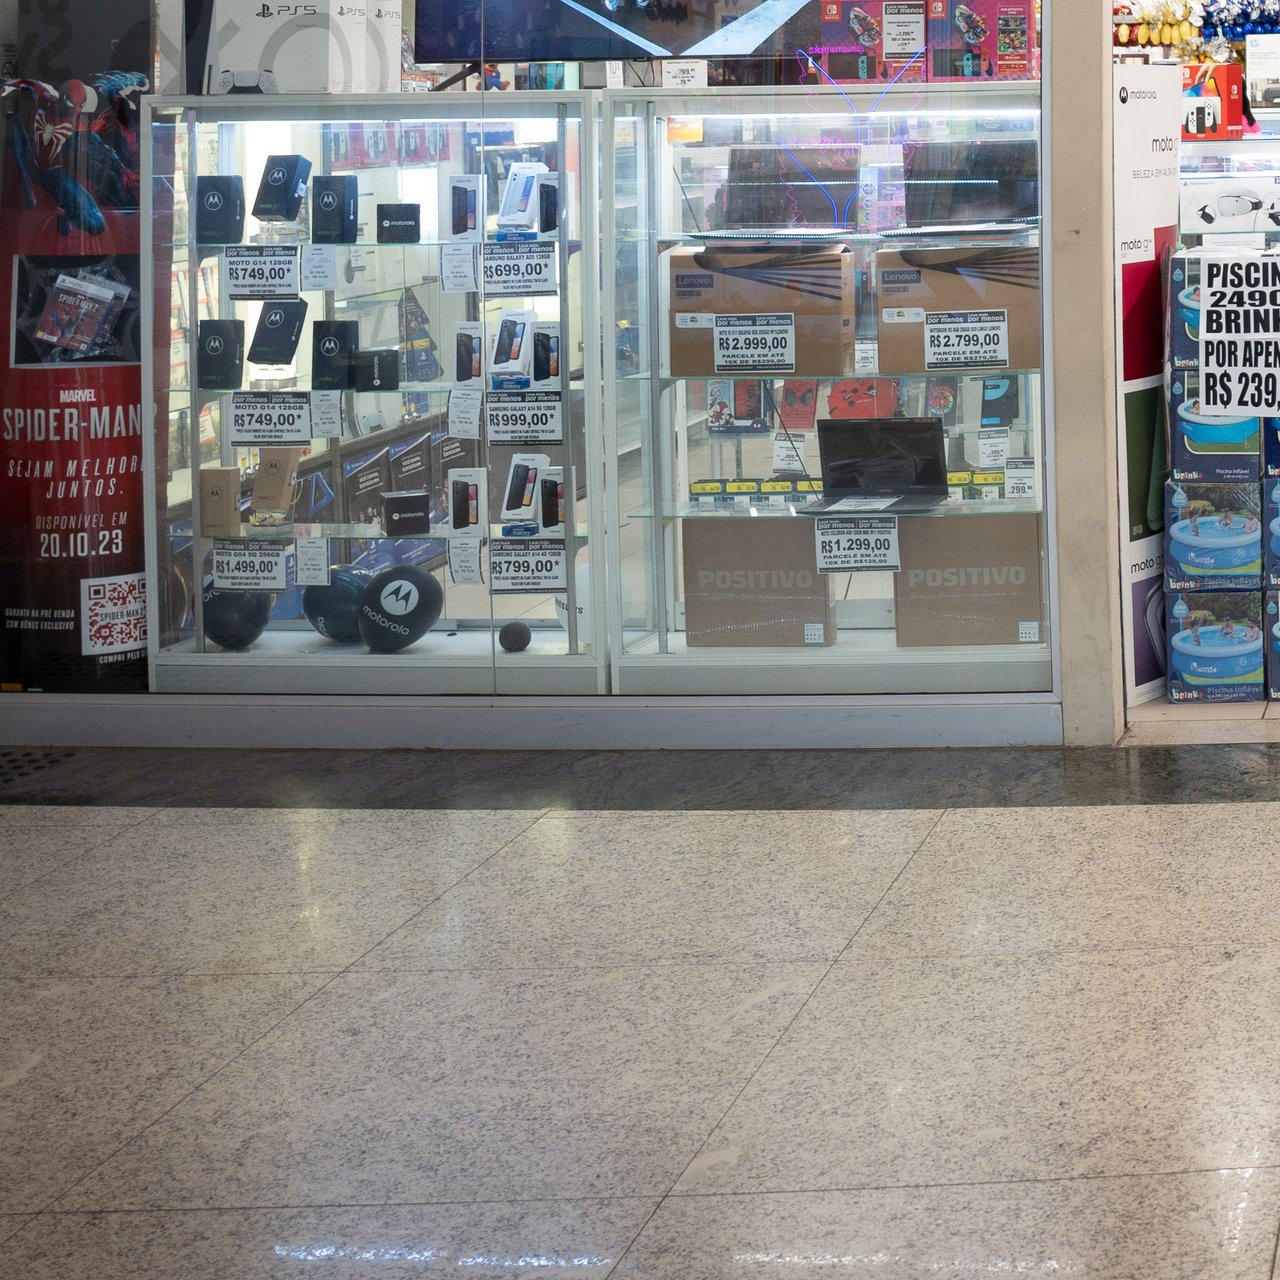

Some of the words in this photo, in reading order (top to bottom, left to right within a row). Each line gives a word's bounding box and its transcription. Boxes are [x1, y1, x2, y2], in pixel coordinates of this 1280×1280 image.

[278, 5, 317, 15] PS5
[1130, 90, 1156, 99] motorola
[679, 277, 710, 285] Lenovo
[885, 273, 917, 281] Lenovo
[1205, 340, 1238, 368] POR
[60, 389, 96, 402] MARVEL
[1205, 370, 1232, 409] R$
[3, 404, 141, 443] SPIDER-MAN
[8, 459, 54, 478] SEJAM
[46, 478, 124, 499] JUNTOS.
[35, 513, 104, 530] DISPONÍVEL
[112, 511, 128, 525] EM
[41, 529, 123, 558] 20.10.23
[699, 570, 813, 589] POSITIVO
[908, 566, 1026, 588] POSITIVO
[363, 604, 410, 636] motorola
[100, 655, 125, 664] COMPRE
